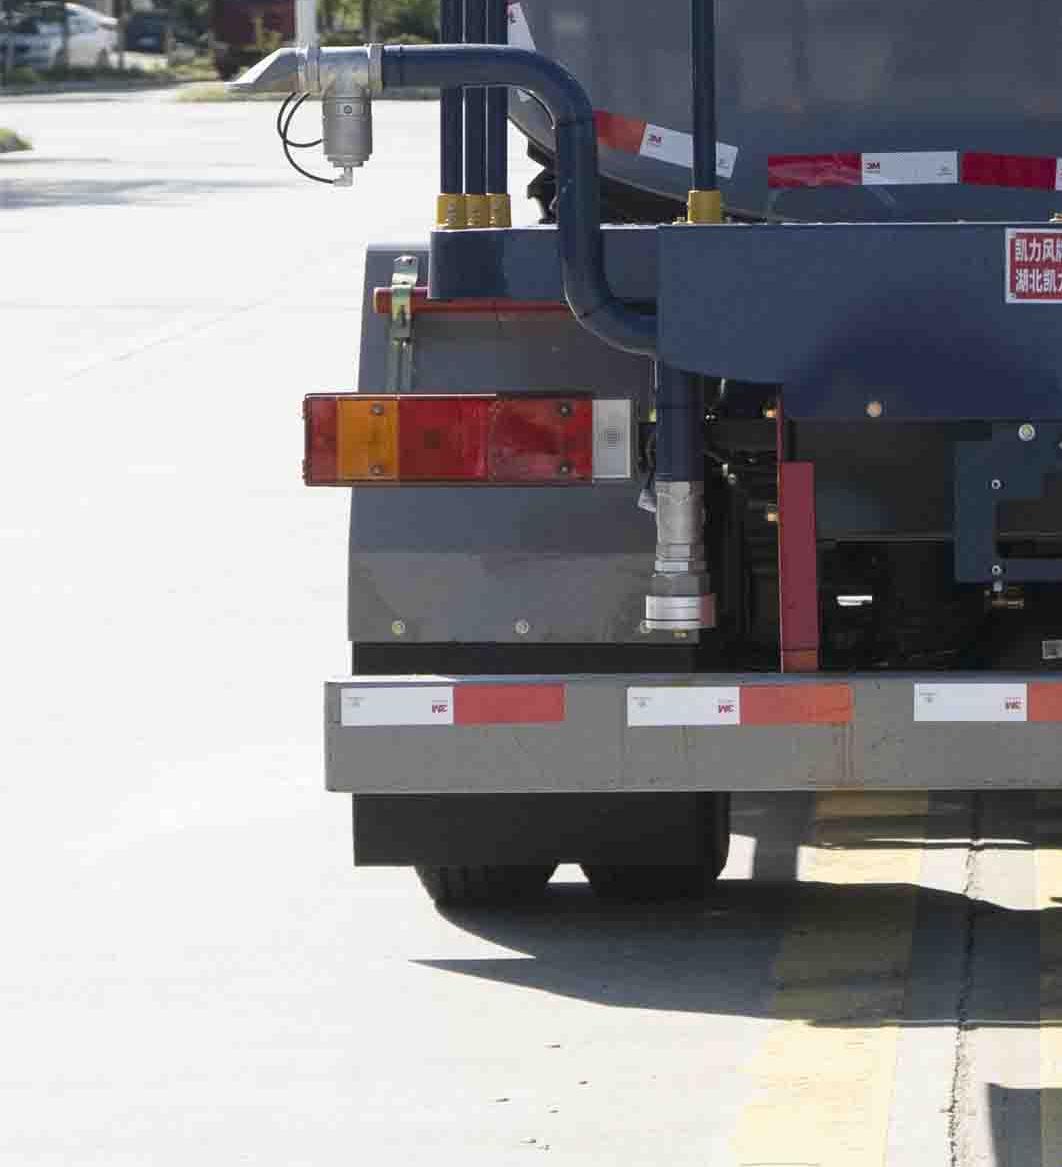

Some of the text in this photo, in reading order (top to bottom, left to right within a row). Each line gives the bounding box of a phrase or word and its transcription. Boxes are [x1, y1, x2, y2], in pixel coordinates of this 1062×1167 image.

[866, 162, 881, 170] 3M
[431, 704, 448, 713] 3M
[718, 704, 734, 713] 3M
[1005, 701, 1023, 710] 3M
